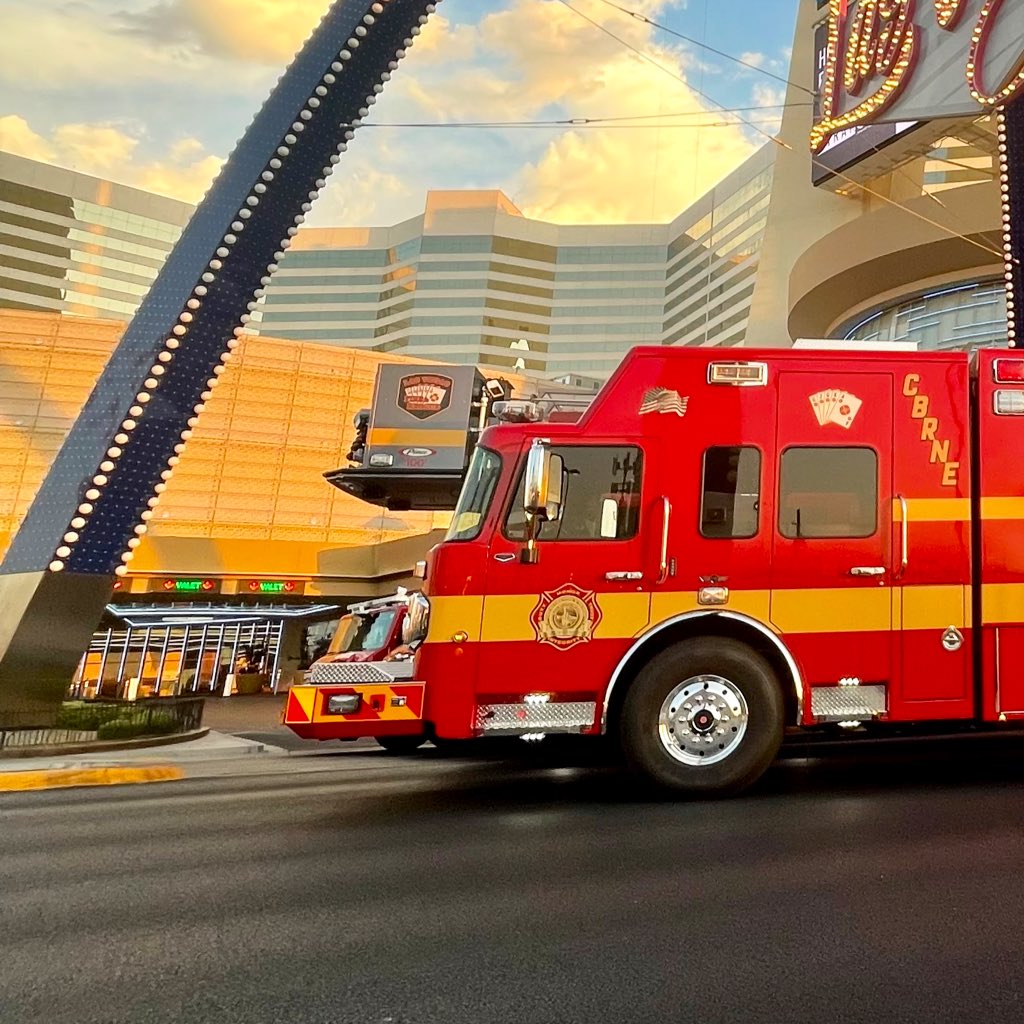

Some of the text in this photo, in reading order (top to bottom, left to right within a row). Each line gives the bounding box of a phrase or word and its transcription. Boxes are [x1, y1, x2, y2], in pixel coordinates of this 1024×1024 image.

[902, 373, 960, 486] CBRNE
[175, 581, 203, 590] VALET
[259, 582, 285, 591] VALET
